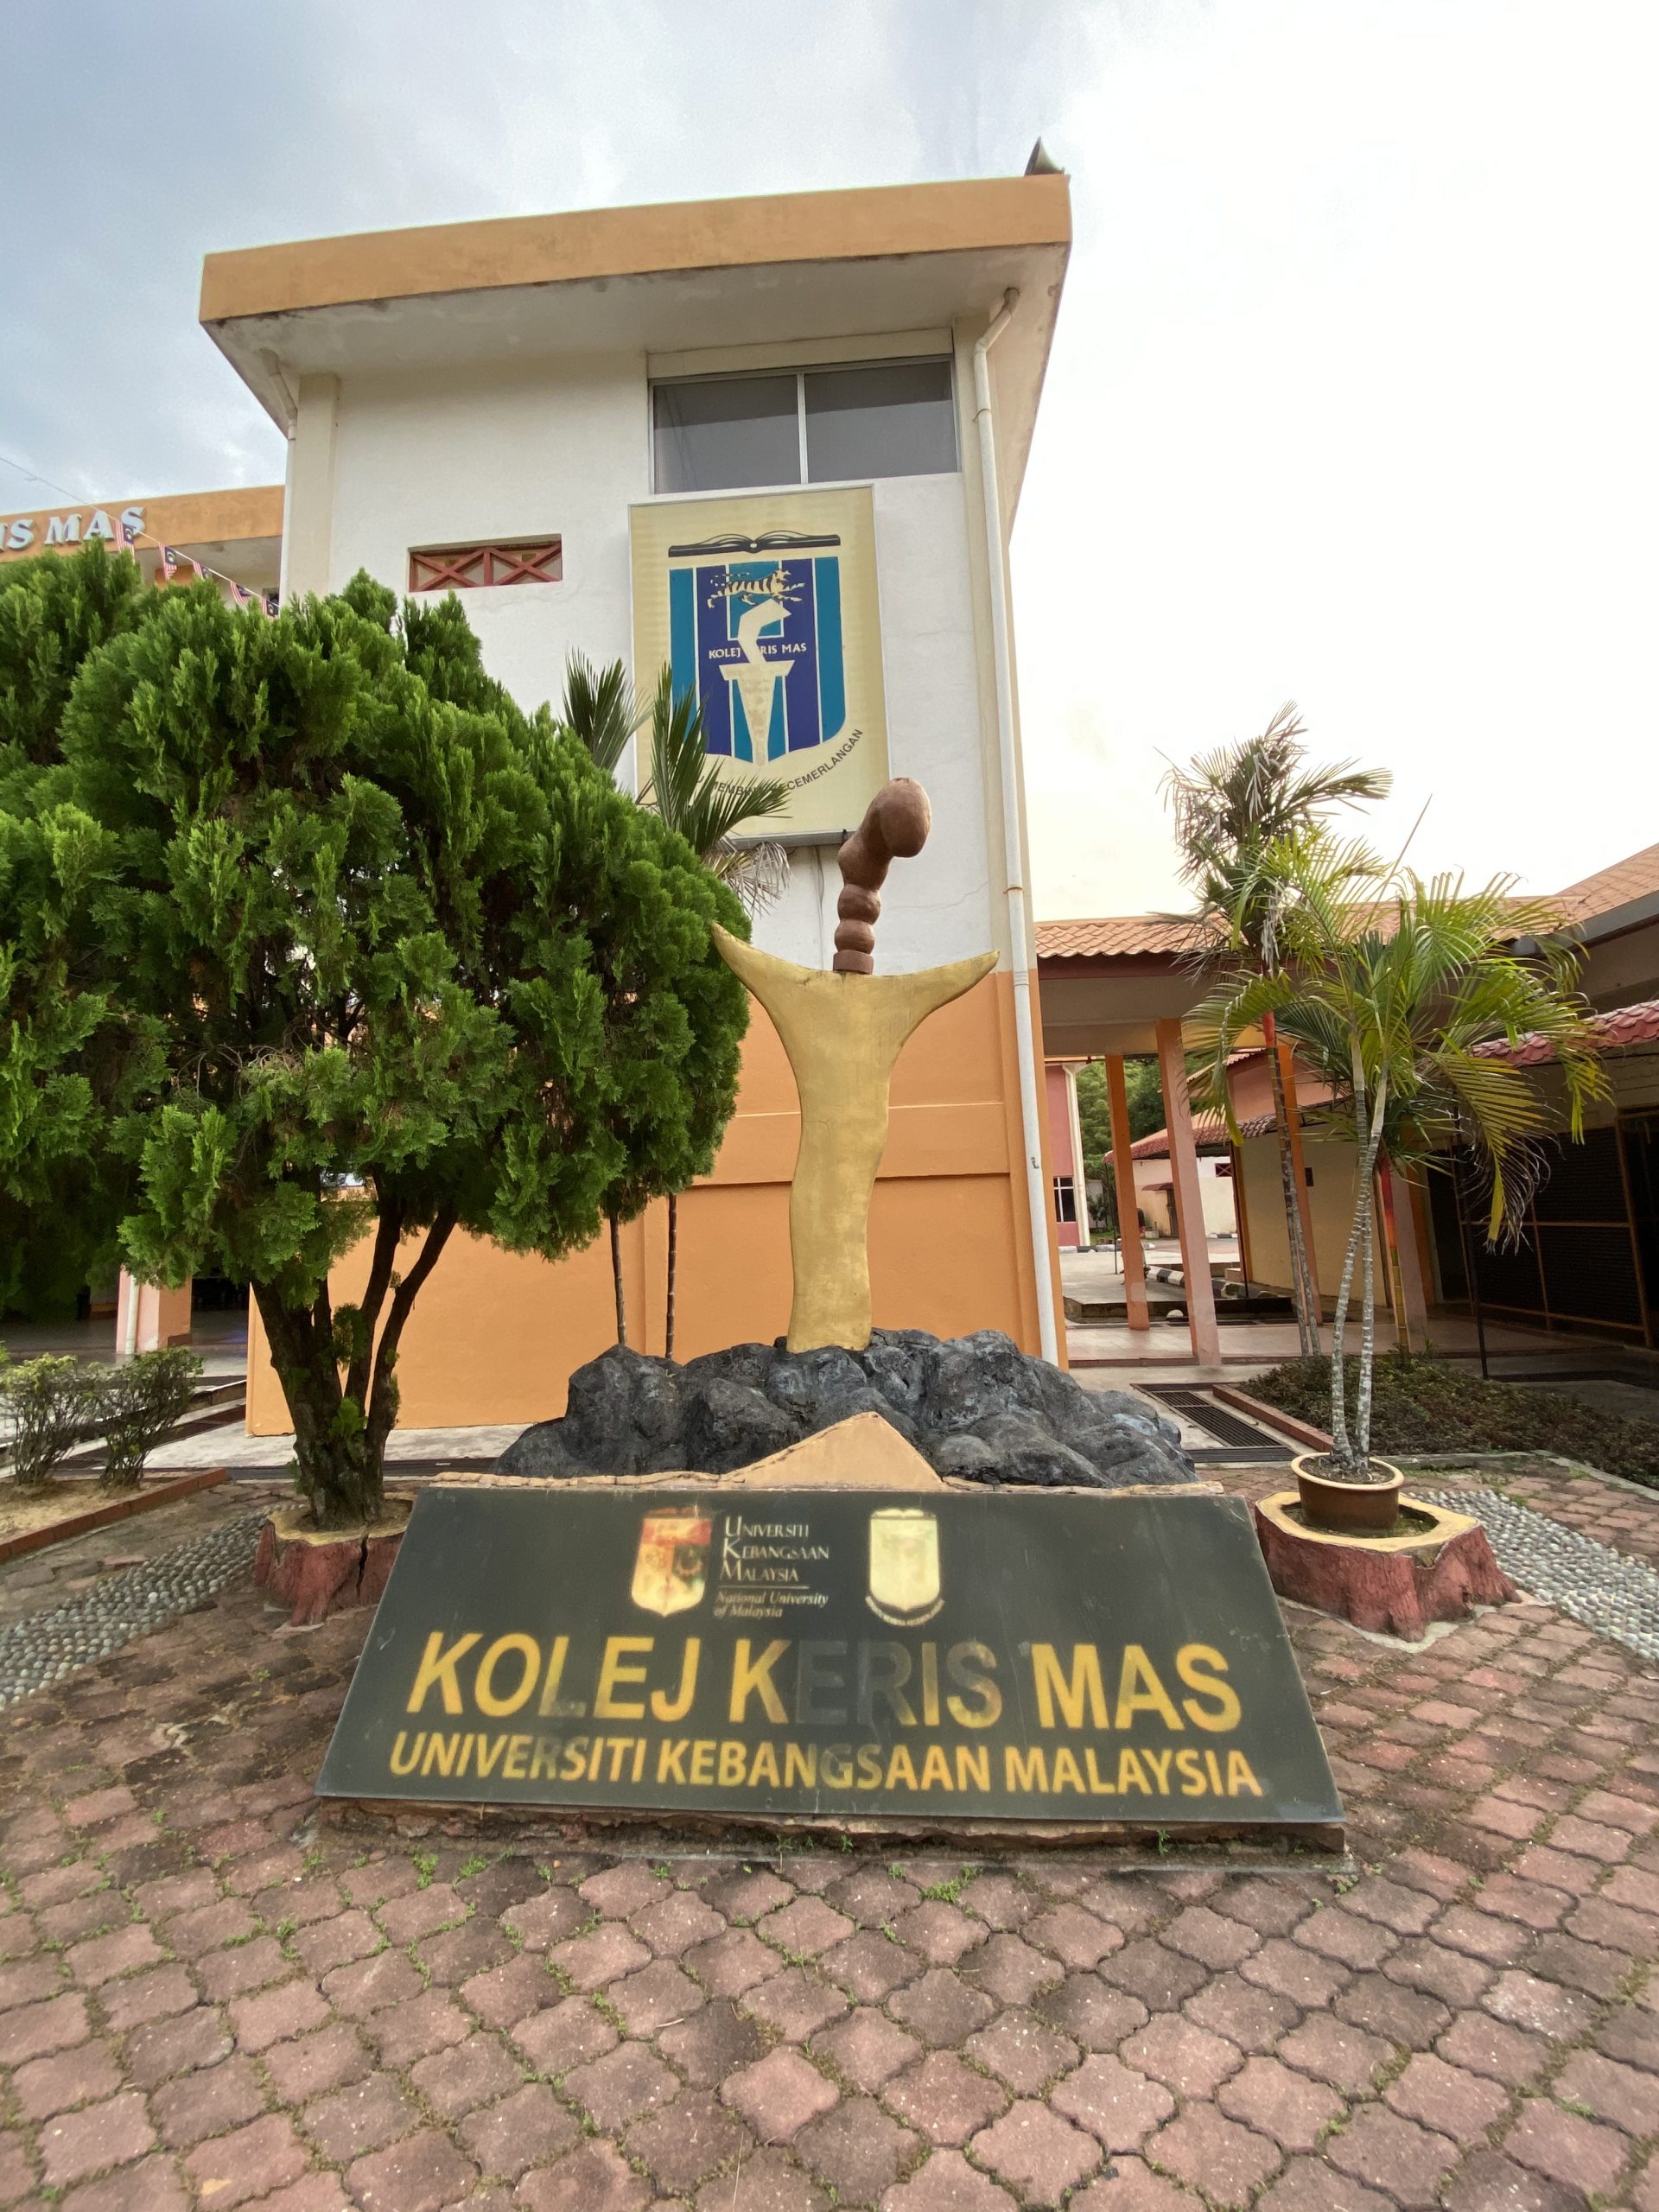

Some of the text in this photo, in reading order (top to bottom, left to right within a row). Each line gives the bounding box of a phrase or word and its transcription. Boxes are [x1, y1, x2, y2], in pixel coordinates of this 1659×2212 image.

[44, 506, 145, 545] MAS
[709, 647, 741, 659] KOLEJ
[781, 642, 807, 653] MAS
[713, 1604, 784, 1620] of Malaysia
[715, 1590, 830, 1608] National University
[406, 1631, 1243, 1732] KOLEJ KERIS MAS
[390, 1731, 1264, 1798] UNIVERSITI KEBANGSAAN MALAYSIA
